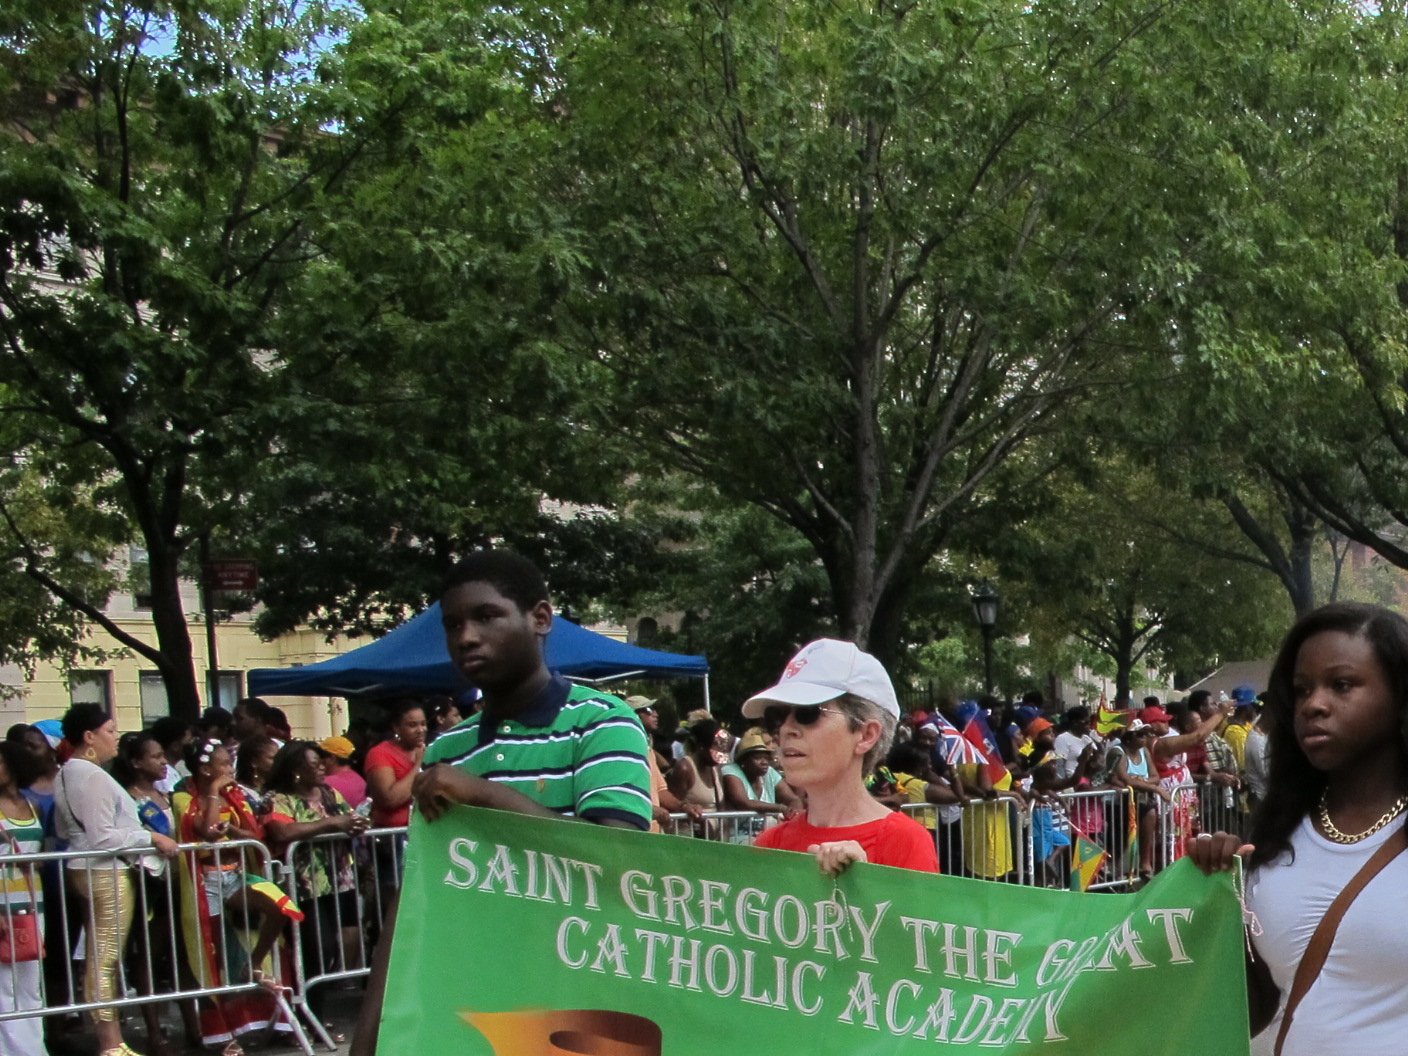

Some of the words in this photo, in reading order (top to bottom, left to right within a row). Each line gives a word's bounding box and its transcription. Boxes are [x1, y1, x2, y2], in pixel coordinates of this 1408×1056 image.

[444, 837, 602, 911] SAINT
[620, 869, 892, 964] GREGORY
[900, 915, 1023, 989] THE
[556, 916, 826, 1017] CATHOLIC
